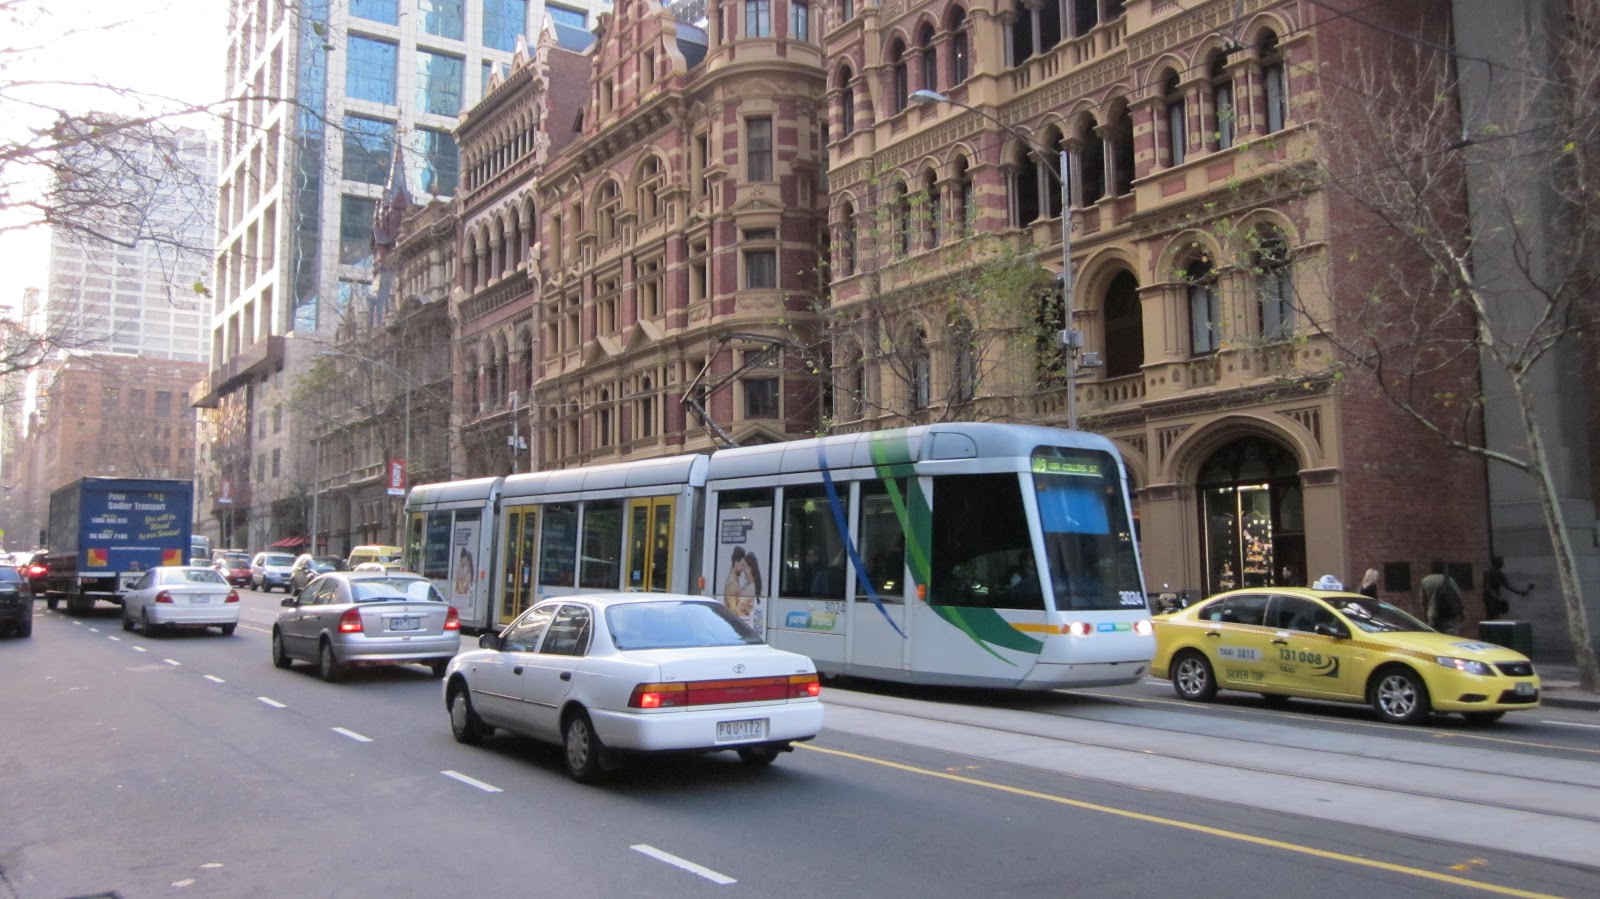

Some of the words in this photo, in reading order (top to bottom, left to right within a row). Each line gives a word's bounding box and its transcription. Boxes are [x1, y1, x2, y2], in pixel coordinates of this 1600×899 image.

[108, 501, 132, 510] Sadler
[134, 502, 166, 511] Transport
[1118, 591, 1143, 605] 3024
[824, 601, 845, 614] 3024
[1219, 648, 1234, 656] TAXI
[1279, 648, 1296, 662] 131
[1298, 652, 1322, 665] 008
[1226, 668, 1249, 680] SILVER
[1251, 670, 1264, 681] TOP
